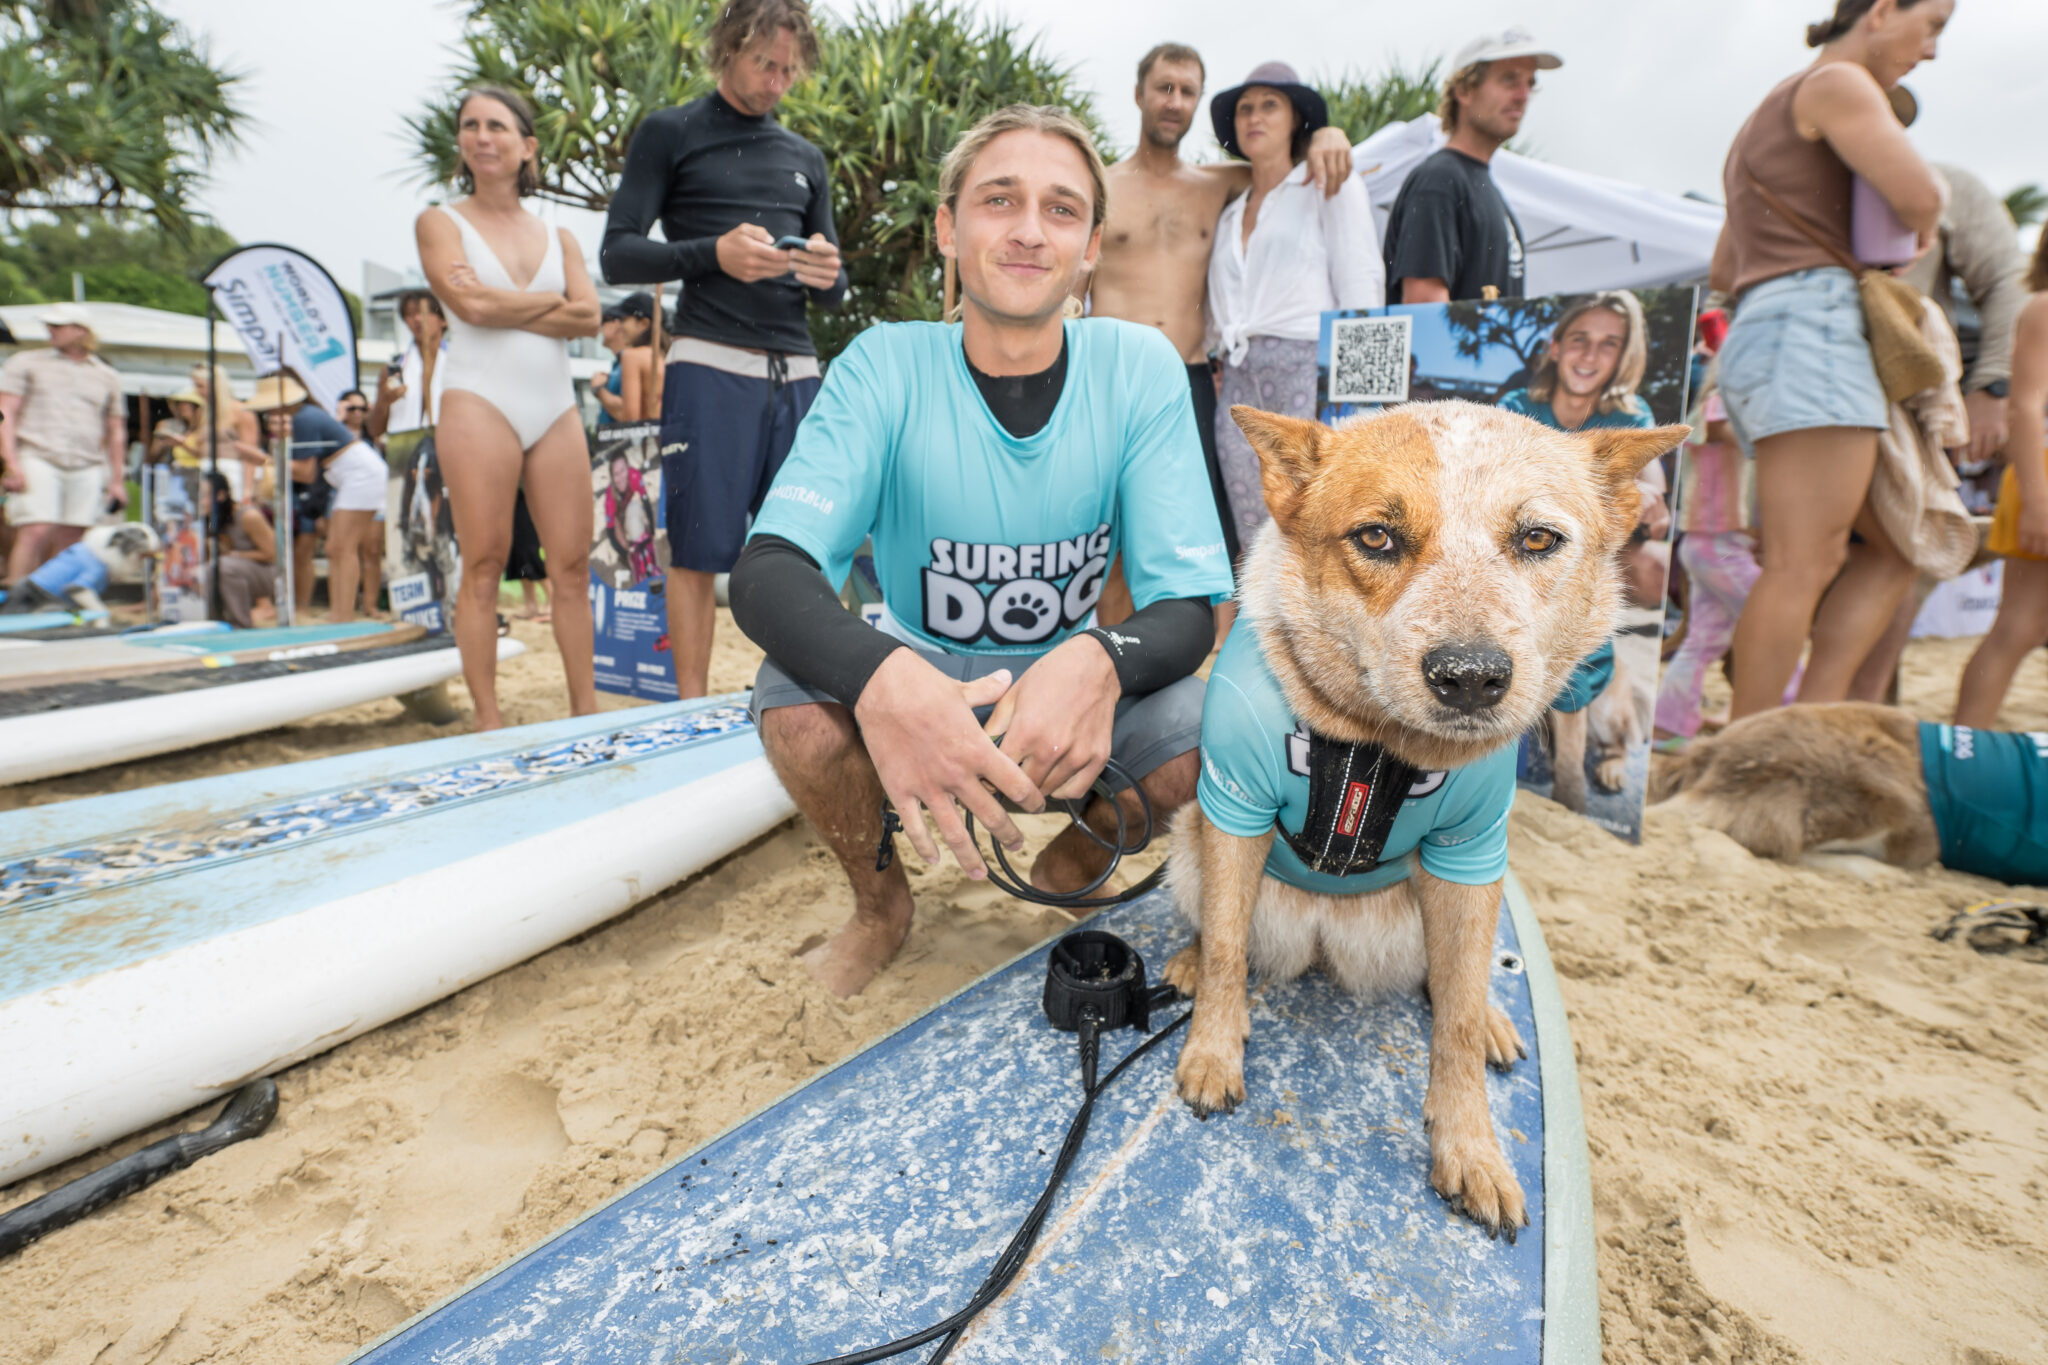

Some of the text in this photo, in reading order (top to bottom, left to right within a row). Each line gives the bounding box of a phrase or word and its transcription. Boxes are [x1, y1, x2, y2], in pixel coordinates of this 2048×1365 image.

[264, 263, 320, 348] NUMBER
[282, 260, 328, 334] WORLD'S
[929, 522, 1111, 584] SURFING
[920, 555, 1108, 645] DOG
